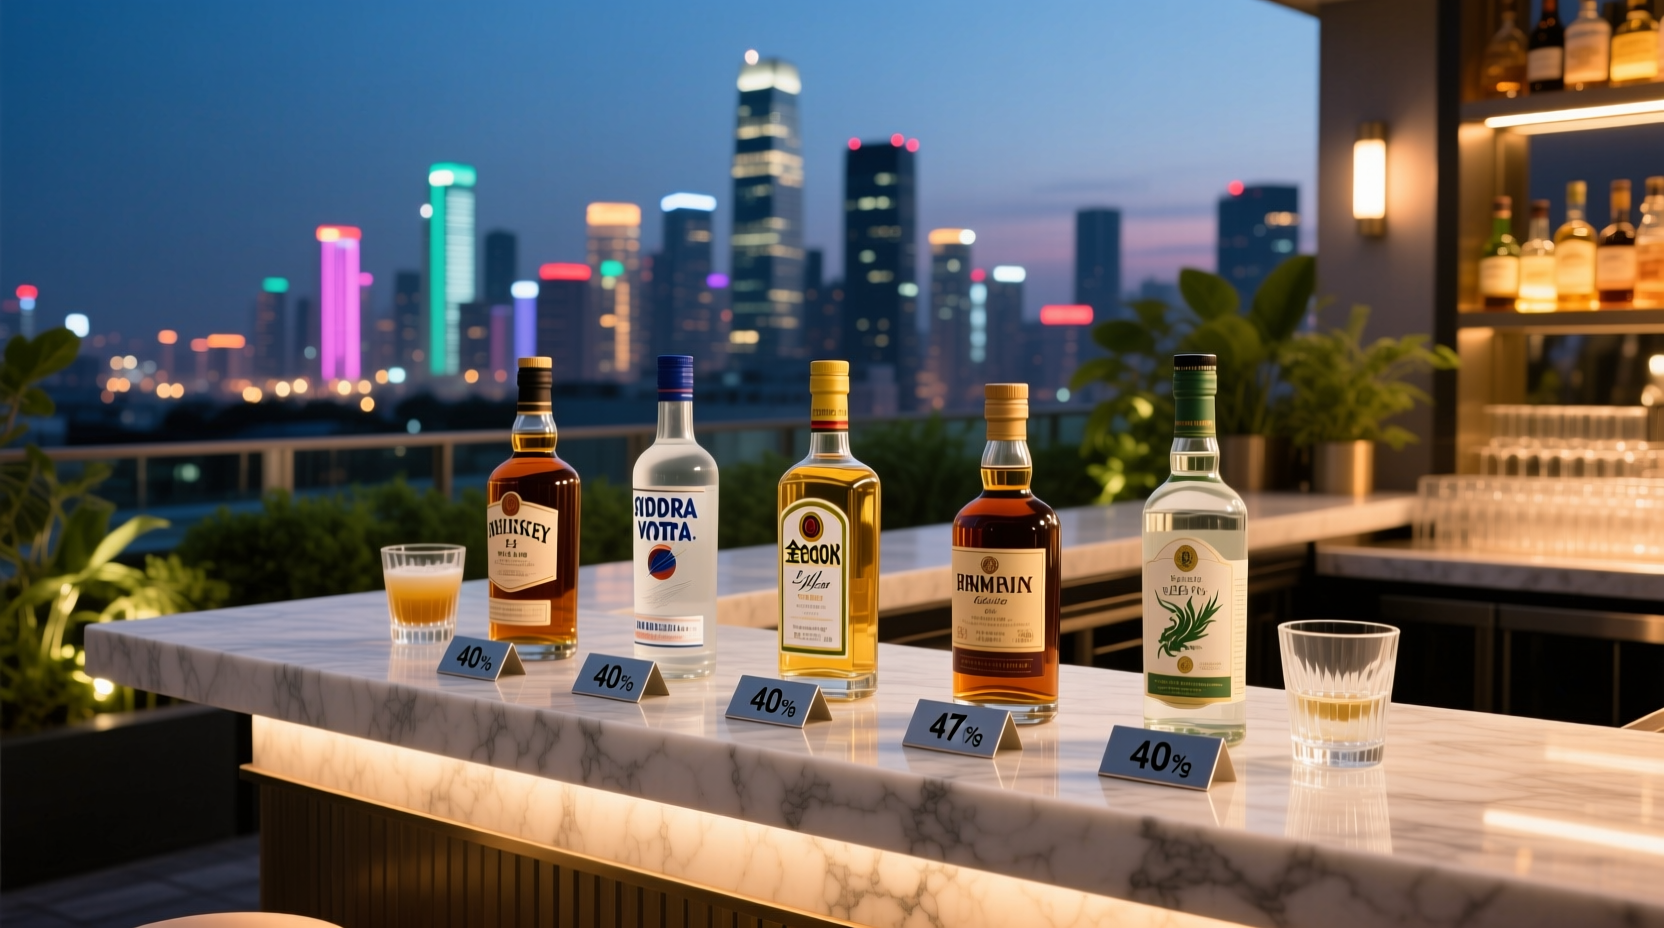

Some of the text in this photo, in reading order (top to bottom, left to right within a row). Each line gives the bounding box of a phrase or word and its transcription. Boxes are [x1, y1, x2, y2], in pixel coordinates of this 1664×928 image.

[456, 644, 492, 672] 40%
[593, 664, 634, 692] 40%
[750, 686, 796, 718] 40%
[929, 712, 983, 748] 47%
